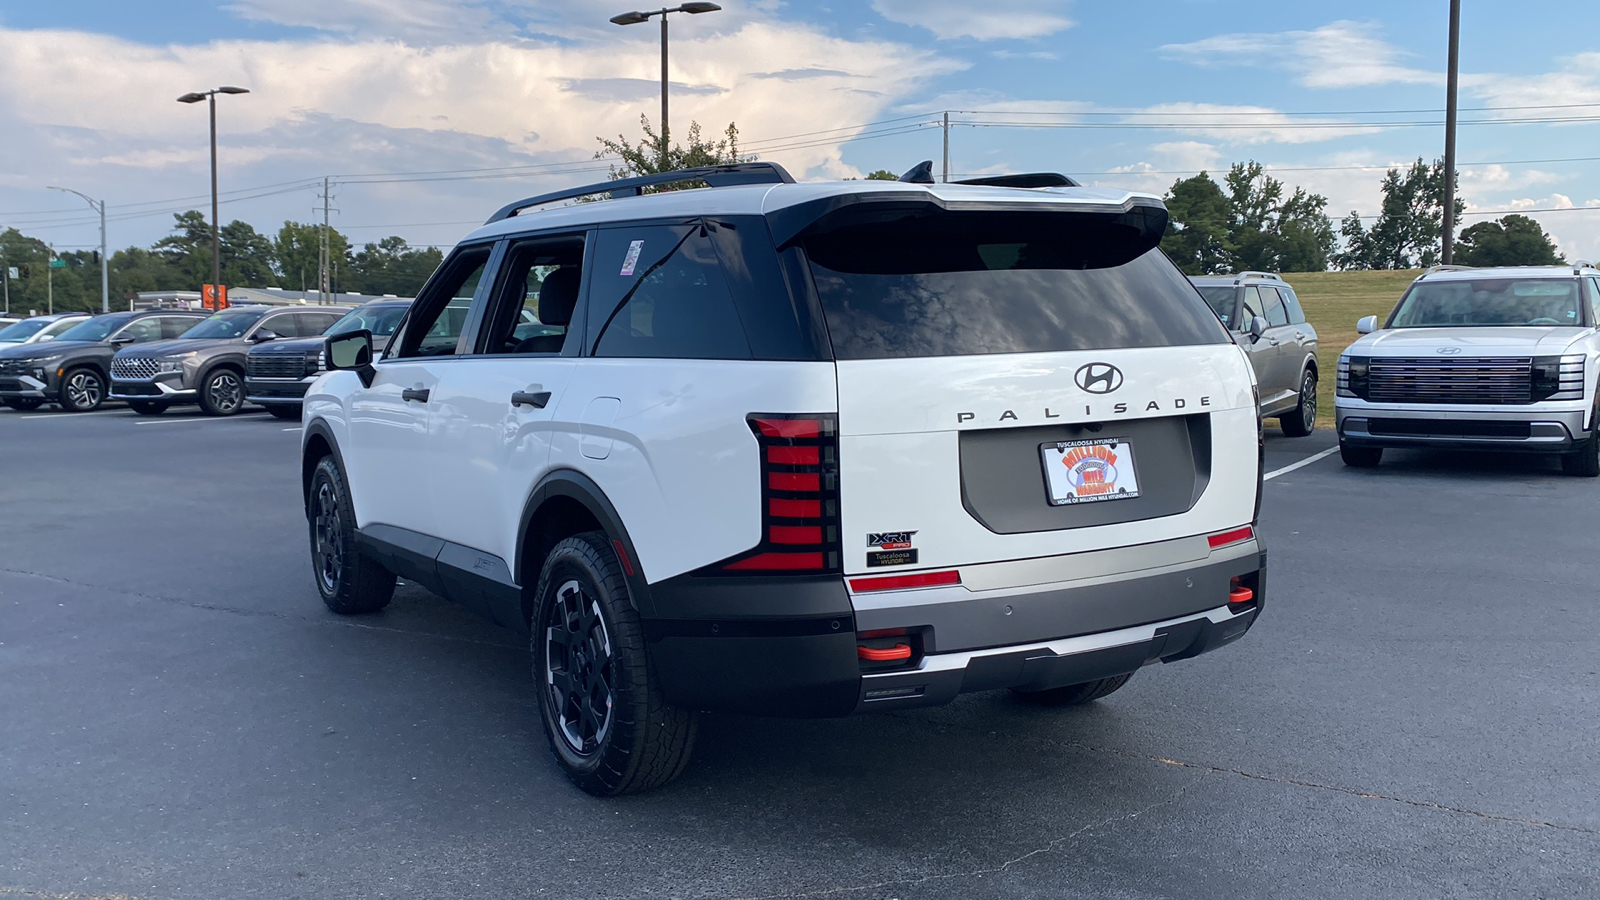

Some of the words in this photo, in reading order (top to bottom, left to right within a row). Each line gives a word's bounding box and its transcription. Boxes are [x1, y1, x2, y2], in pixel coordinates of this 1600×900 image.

[957, 396, 1211, 423] PALISADE
[1057, 440, 1093, 448] TUSCALOOSA
[1061, 445, 1118, 471] MILLION
[1082, 469, 1104, 484] MILE
[1075, 482, 1115, 496] WARRANTY
[867, 530, 918, 547] XRT
[875, 552, 910, 560] Tuscaloosa
